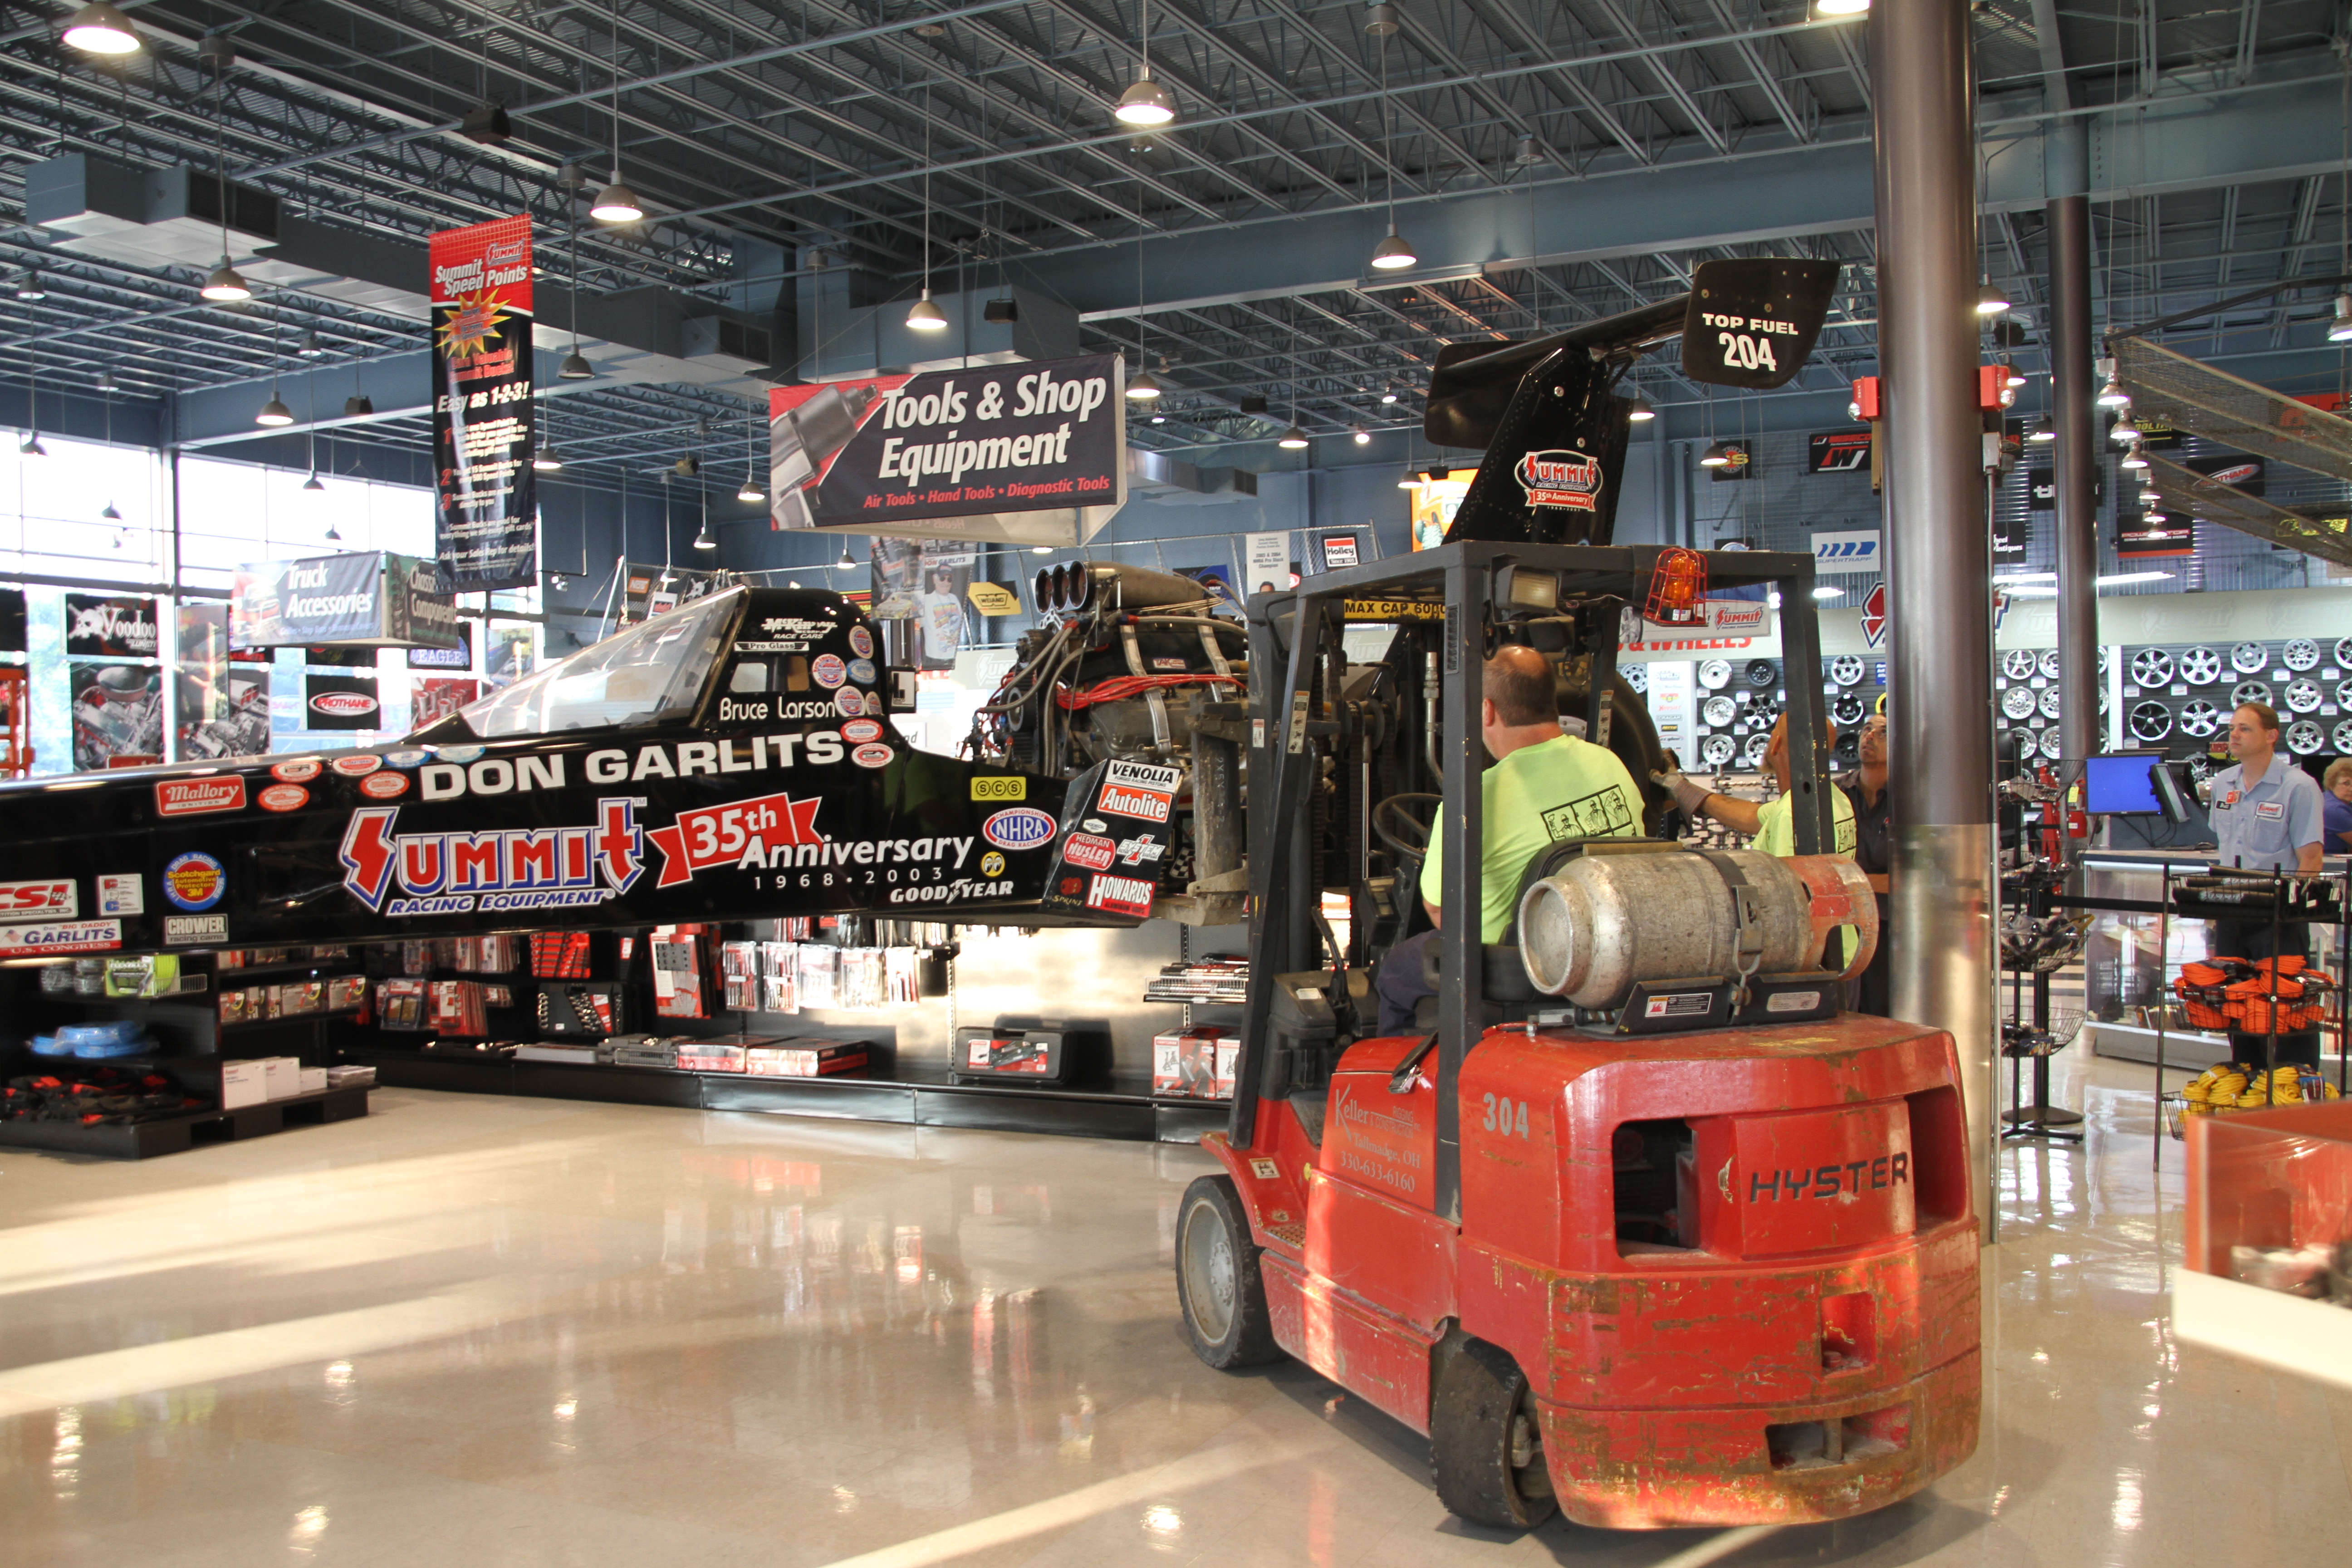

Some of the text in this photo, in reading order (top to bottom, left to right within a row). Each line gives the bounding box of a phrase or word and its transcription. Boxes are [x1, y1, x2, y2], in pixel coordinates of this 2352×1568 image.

[435, 259, 483, 284] Summit
[444, 265, 527, 298] Speed Points
[1702, 313, 1798, 335] TOP FUEL
[472, 348, 513, 366] Valuable
[1719, 332, 1777, 372] 204
[437, 381, 530, 413] Easy as 1-2-3!
[882, 370, 1106, 429] Tools & Shop
[444, 427, 452, 444] 1
[878, 422, 1071, 487] Equipment
[440, 468, 452, 486] 2
[442, 493, 452, 510] 3
[863, 475, 1110, 509] Air Tools Hand Tools Diagnostic Tools
[1536, 491, 1588, 505] 35th Anniversary
[1993, 534, 2009, 544] heel
[438, 550, 451, 561] Ask
[451, 551, 469, 562] your
[468, 548, 485, 559] Sales
[498, 545, 509, 554] for
[939, 557, 966, 565] GARLITS
[1327, 547, 1354, 556] Holley
[287, 561, 330, 590] Truck
[285, 588, 373, 619] Accessories
[1345, 603, 1375, 613] MAX
[1381, 603, 1408, 613] CAP
[96, 606, 157, 641] Voodoo
[417, 649, 464, 666] EAGLE
[316, 698, 372, 710] PROTHANE
[720, 696, 836, 721] Bruce Larson
[421, 730, 844, 801] DON GARLITS
[1112, 763, 1175, 784] VENOLIA
[167, 783, 240, 802] Mallory
[978, 782, 1019, 794] SCS
[1147, 779, 1166, 788] PISTONS
[176, 800, 220, 808] IGNITION
[1101, 787, 1167, 819] Autolite
[996, 809, 1046, 819] CHAMPIONSHIP
[691, 805, 777, 859] 35th
[996, 816, 1044, 840] NHRA
[1018, 838, 1042, 848] RACING
[1076, 834, 1110, 848] HEDMAN
[1119, 841, 1159, 856] SYSTEM
[192, 853, 218, 867] RACING
[738, 834, 975, 869] Anniversary
[1067, 842, 1112, 867] HUSLER
[167, 868, 221, 879] Scotchgard
[187, 888, 204, 897] 3M
[890, 879, 1014, 904] GOODYEAR
[1051, 894, 1083, 906] SPRINT
[1088, 875, 1153, 907] HOWARDS
[387, 890, 606, 917] RACING EQUIPMENT
[168, 916, 225, 935] CROWER
[24, 927, 116, 945] GARLITS
[41, 941, 111, 952] CONGRESS
[1335, 1083, 1368, 1142] Keller
[1392, 1106, 1414, 1123] RIGGING
[1483, 1092, 1529, 1139] 304
[1375, 1117, 1414, 1139] CONSTRUCTION
[1353, 1132, 1421, 1169] Tallmadge, OH
[1340, 1151, 1416, 1193] 330-633-6160
[1750, 1152, 1908, 1204] HYSTER
